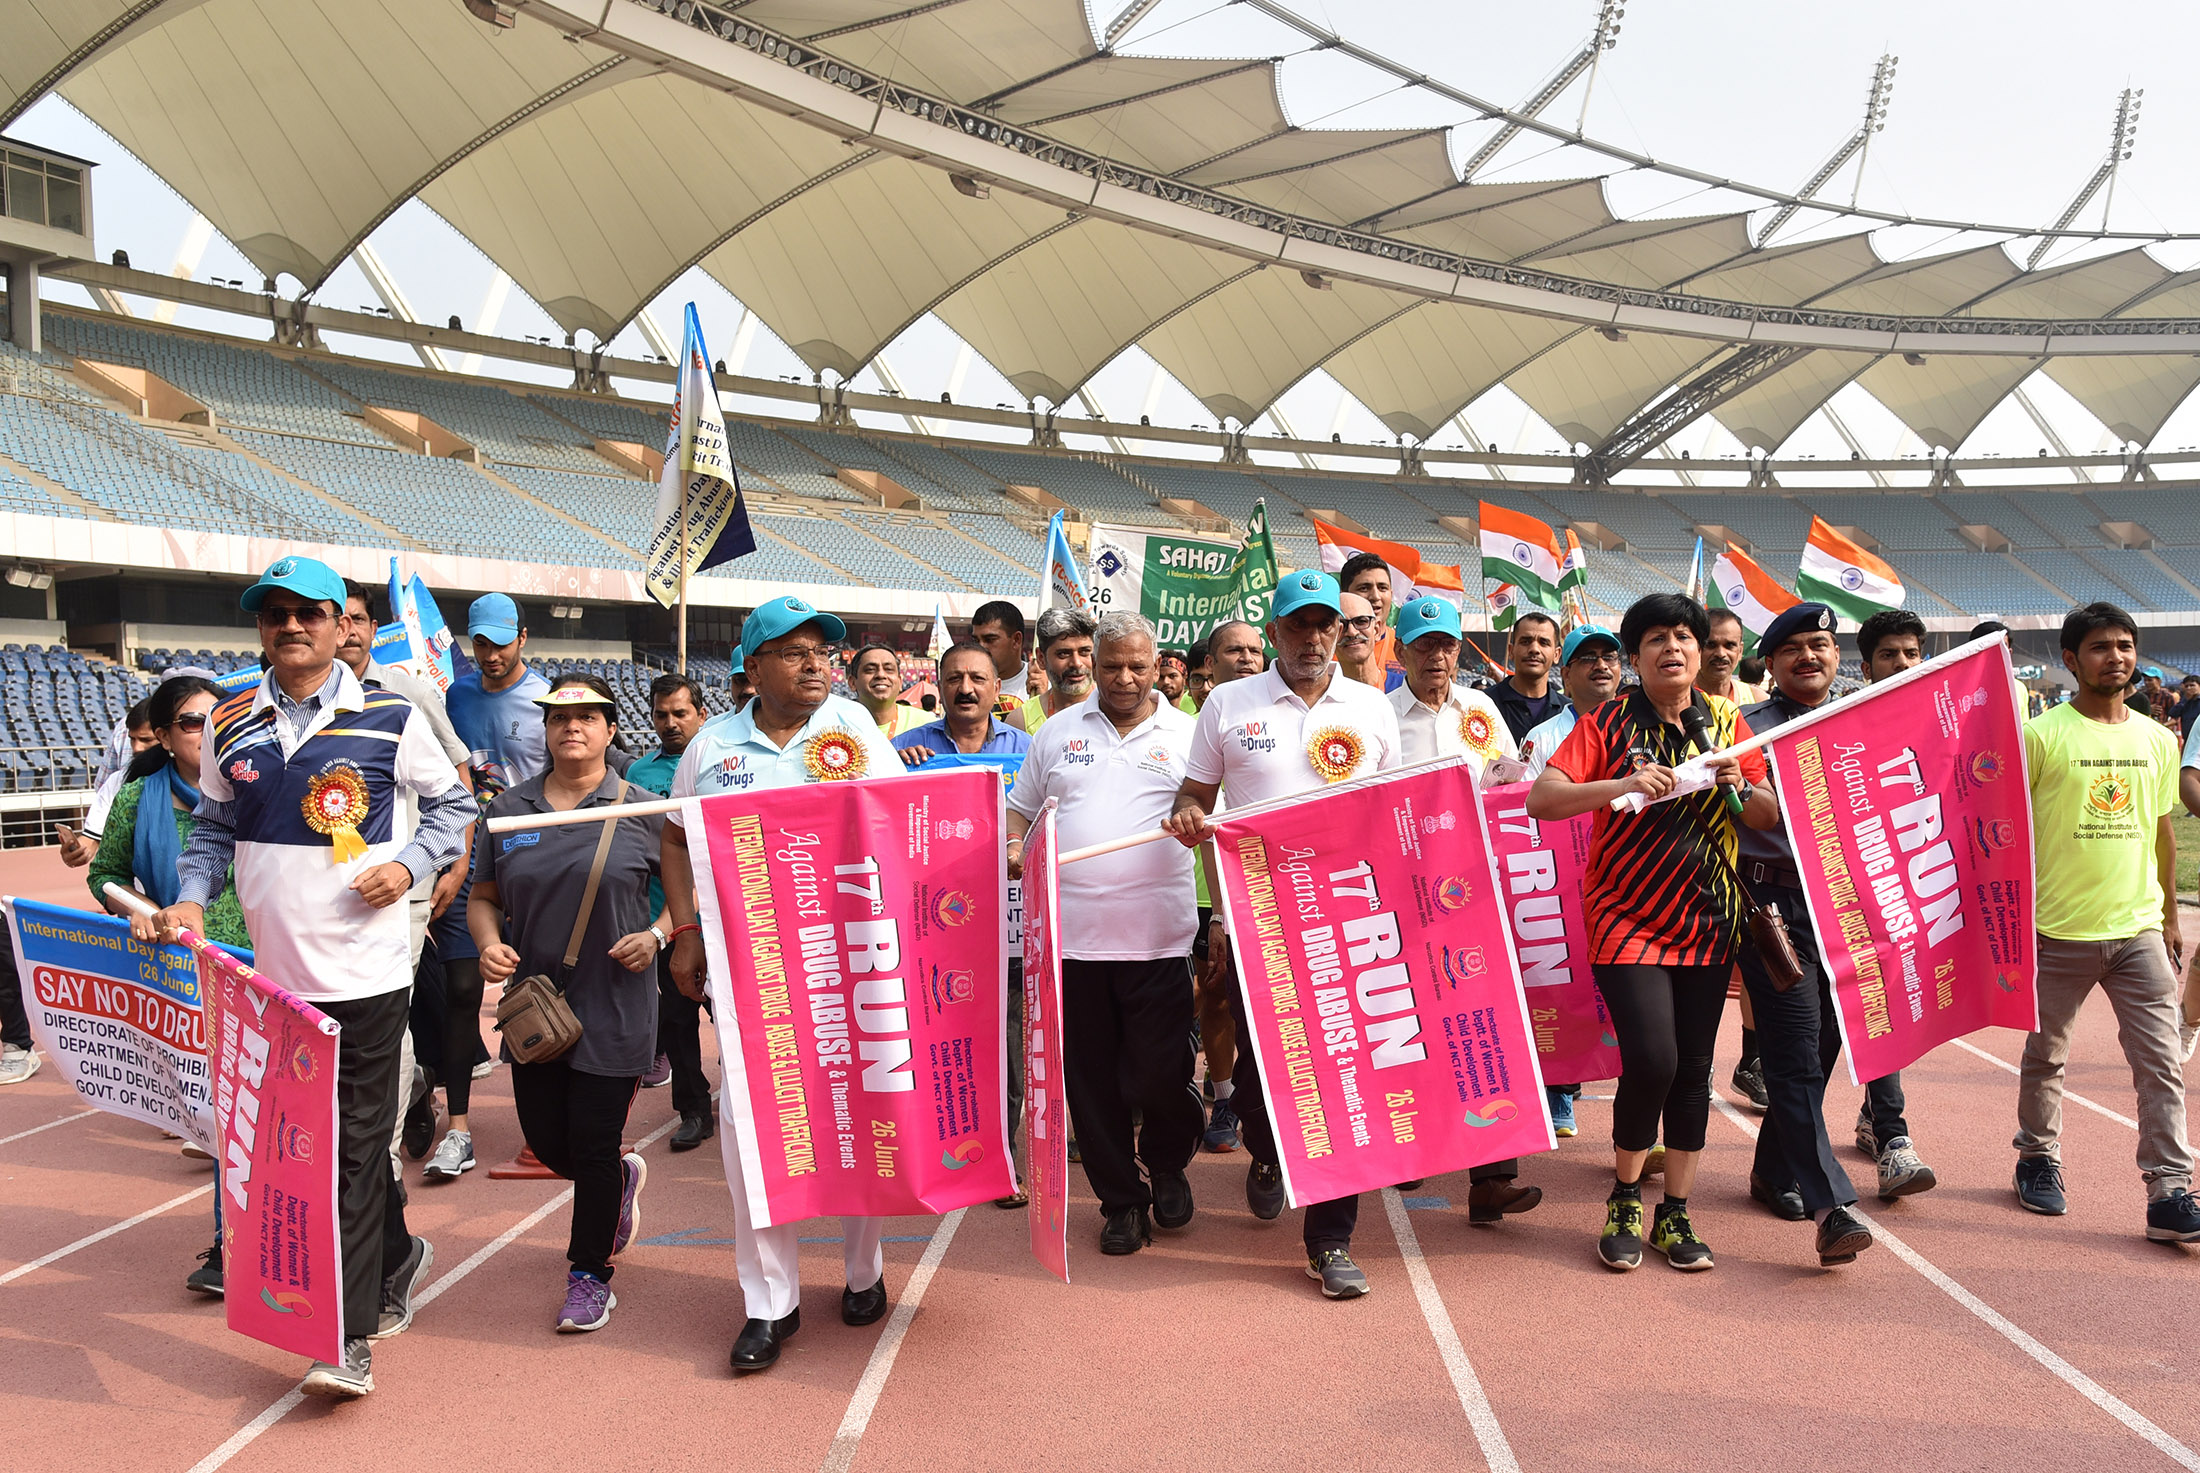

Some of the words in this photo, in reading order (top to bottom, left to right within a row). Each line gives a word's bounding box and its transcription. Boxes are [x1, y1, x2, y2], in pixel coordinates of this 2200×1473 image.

[662, 578, 673, 589] &
[692, 488, 733, 546] Trafficking
[649, 538, 681, 581] against
[1100, 559, 1114, 569] SS
[1160, 545, 1227, 575] SAHAJ
[1053, 560, 1086, 607] rcotics
[1090, 587, 1111, 604] 26
[1156, 619, 1206, 644] DAY
[1069, 740, 1082, 751] NO
[1237, 728, 1246, 738] say
[1247, 723, 1260, 736] NO
[1241, 739, 1247, 747] to
[1247, 738, 1275, 752] Drugs
[723, 756, 738, 771] NO
[1069, 753, 1094, 766] Drugs
[1877, 747, 1924, 795] 17th
[2093, 759, 2115, 767] AGAINST
[2132, 759, 2148, 767] ABUSE
[723, 772, 754, 788] Drugs
[1795, 736, 1831, 819] INTERNATIONAL
[1831, 741, 1874, 815] Against
[1811, 813, 1837, 838] DAY
[730, 814, 772, 910] INTERNATIONAL
[1816, 835, 1848, 880] AGAINST
[1853, 815, 1893, 876] DRUG
[775, 828, 827, 918] Against
[834, 855, 884, 915] 17th
[1237, 836, 1277, 917] INTERNATIONAL
[1277, 845, 1324, 922] Against
[1328, 860, 1380, 911] 17th
[1890, 794, 1962, 947] RUN
[1827, 875, 1858, 909] DRUG
[1871, 873, 1917, 942] ABUSE
[1989, 880, 2004, 903] Child
[745, 908, 777, 933] DAY
[1254, 914, 1282, 938] DAY
[1506, 849, 1570, 986] RUN
[1837, 909, 1869, 943] ABUSE
[1995, 905, 2010, 963] Development
[22, 918, 122, 951] International
[127, 937, 155, 962] Day
[798, 923, 841, 989] DRUG
[1301, 925, 1342, 985] DRUG
[1847, 939, 1872, 952] &
[1898, 940, 1912, 951] &
[750, 936, 785, 984] AGAINST
[1259, 939, 1293, 983] AGAINST
[1850, 946, 1880, 979] ILLICIT
[1900, 948, 1920, 992] Thematic
[1934, 958, 1954, 979] 26
[139, 962, 158, 981] (26
[161, 972, 201, 1001] June)
[1270, 982, 1299, 1014] DRUG
[1342, 912, 1424, 1068] RUN
[1935, 976, 1956, 1009] June
[39, 971, 85, 1008] SAY
[94, 980, 130, 1017] NO
[135, 991, 160, 1031] TO
[758, 985, 791, 1019] DRUG
[845, 918, 913, 1092] RUN
[1532, 1007, 1557, 1021] 26
[1858, 976, 1891, 1039] TRAFFICKING
[1907, 990, 1923, 1022] Events
[44, 1013, 138, 1045] DIRECTORATE
[141, 1035, 156, 1056] OF
[808, 993, 851, 1066] ABUSE
[1277, 1017, 1307, 1050] ABUSE
[1314, 986, 1358, 1055] ABUSE
[1442, 1016, 1453, 1039] Govt.
[1455, 1013, 1470, 1036] Child
[1472, 1009, 1486, 1038] Deptt.
[1534, 1023, 1559, 1052] June
[764, 1023, 797, 1059] ABUSE
[929, 1043, 938, 1068] Govt.
[940, 1041, 951, 1066] Child
[951, 1039, 963, 1070] Deptt.
[964, 1037, 973, 1079] Directorate
[1284, 1049, 1310, 1060] &
[1447, 1040, 1457, 1049] of
[1478, 1039, 1490, 1048] of
[1485, 1007, 1499, 1045] Directorate
[1496, 1054, 1510, 1092] Prohibition
[59, 1035, 149, 1070] DEPARTMENT
[152, 1059, 165, 1078] OF
[166, 1068, 207, 1102] WOMEN
[80, 1060, 122, 1082] CHILD
[770, 1059, 799, 1069] &
[828, 1070, 845, 1078] &
[932, 1071, 939, 1080] of
[1286, 1057, 1317, 1091] ILLICIT
[1336, 1056, 1353, 1065] &
[1450, 1051, 1461, 1067] NCT
[1454, 1069, 1463, 1078] of
[1461, 1039, 1483, 1098] Development
[1481, 1050, 1496, 1085] Women
[772, 1067, 805, 1104] ILLICIT
[956, 1072, 965, 1082] of
[968, 1080, 976, 1088] of
[1339, 1065, 1364, 1112] Thematic
[1456, 1080, 1467, 1102] Delhi
[1489, 1086, 1500, 1094] &
[76, 1078, 116, 1101] GOVT.
[120, 1089, 138, 1106] OF
[141, 1095, 165, 1116] NCT
[168, 1106, 182, 1126] OF
[830, 1081, 853, 1130] Thematic
[936, 1104, 943, 1113] of
[943, 1070, 958, 1137] Development
[958, 1085, 968, 1123] Women
[970, 1090, 979, 1132] Prohibition
[1385, 1089, 1414, 1107] 26
[226, 1024, 269, 1209] RUN
[871, 1119, 896, 1137] 26
[937, 1116, 945, 1140] Delhi
[962, 1125, 970, 1133] &
[1294, 1090, 1332, 1158] TRAFFICKING
[1349, 1112, 1371, 1146] Events
[1389, 1110, 1418, 1143] June
[778, 1103, 816, 1176] TRAFFICKING
[837, 1133, 856, 1168] Events
[873, 1140, 898, 1177] June
[273, 1189, 282, 1216] Child
[287, 1195, 297, 1225] Deptt.
[272, 1217, 282, 1282] Development
[287, 1227, 298, 1240] of
[288, 1241, 297, 1277] Women
[289, 1278, 299, 1286] &
